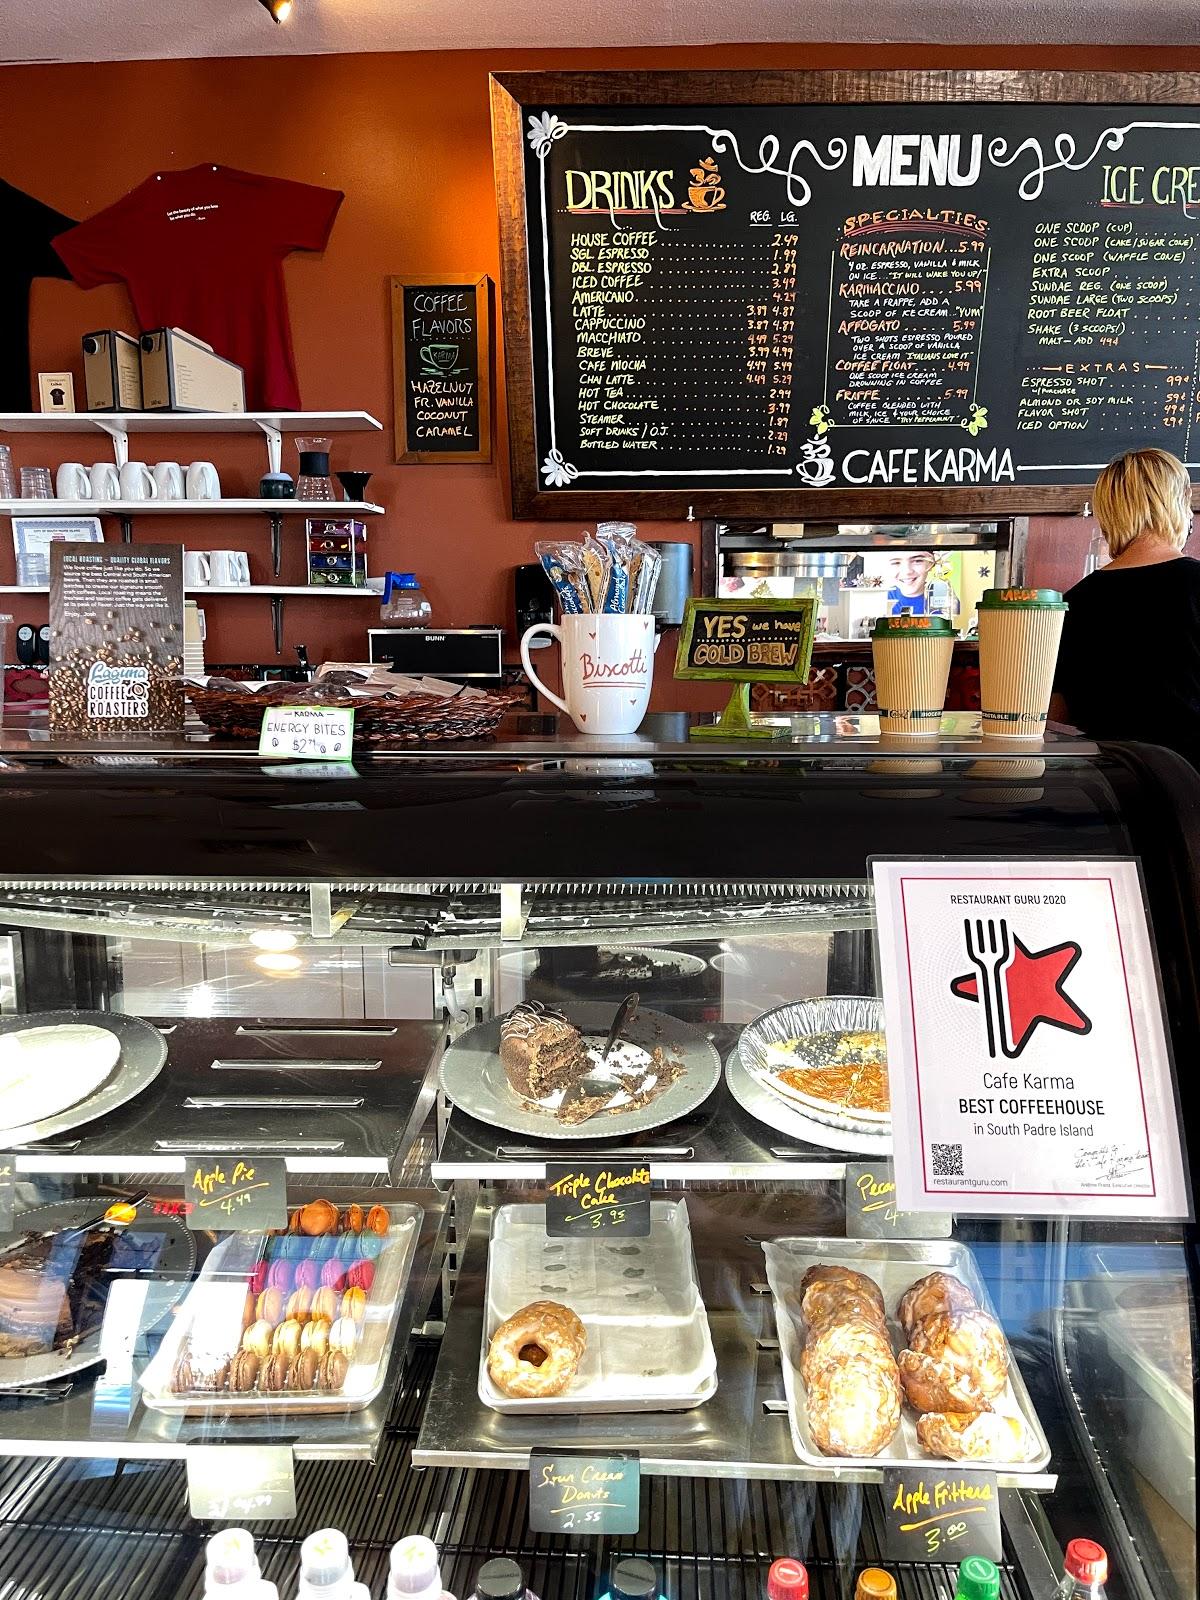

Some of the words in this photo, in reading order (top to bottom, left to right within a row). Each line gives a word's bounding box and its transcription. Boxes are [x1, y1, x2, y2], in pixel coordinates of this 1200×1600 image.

[853, 134, 982, 186] MENU
[1100, 166, 1144, 204] ICE
[564, 169, 675, 217] DRINKS
[750, 210, 771, 223] REG.
[781, 211, 798, 222] LG.
[1035, 224, 1061, 234] ONE
[1065, 222, 1100, 233] SCOOP
[1106, 222, 1132, 235] (CUP)
[571, 233, 609, 246] HOUSE
[613, 231, 657, 246] COFFEE
[771, 234, 798, 246] 2.49
[1034, 237, 1059, 247] ONE
[1063, 237, 1100, 247] SCOOP
[598, 248, 649, 260] ESPRESSO
[774, 250, 796, 262] 1.99
[1033, 253, 1060, 263] ONE
[1061, 253, 1094, 262] SCOOP
[1154, 252, 1185, 264] CONE)
[598, 262, 652, 274] ESPRESSO
[1032, 268, 1068, 278] EXTRA
[1075, 267, 1110, 277] SCOOP
[572, 276, 598, 289] ICED
[601, 275, 644, 288] COFFEE
[772, 278, 796, 290] 3.49
[955, 281, 982, 293] 5.99
[1030, 281, 1073, 292] SUNDAE
[1080, 282, 1103, 291] REG.
[1110, 280, 1131, 291] (ONE
[1136, 280, 1167, 292] SCOOP)
[414, 294, 467, 313] COFFEE
[572, 291, 634, 305] AMERICANO
[1029, 294, 1070, 305] SUNDAE
[1076, 294, 1108, 305] LARGE
[1112, 294, 1134, 304] (TWO
[1137, 293, 1178, 304] SCOOPS)
[573, 305, 605, 318] LATTE
[1028, 309, 1057, 319] ROOT
[1060, 309, 1089, 318] BEER
[1096, 308, 1130, 318] FLOAT
[412, 318, 472, 338] FLAVORS
[575, 318, 646, 330] CAPPUCCINO
[838, 320, 900, 335] AFFOGATO
[1028, 324, 1062, 334] SHAKE
[576, 332, 641, 345] MACCHIATO
[576, 346, 614, 358] BREVE
[579, 360, 606, 371] CAFE
[611, 360, 646, 371] MOCHA
[835, 360, 880, 372] COFFEE
[882, 362, 917, 372] FLOAT
[1066, 362, 1140, 374] EXTRAS
[580, 374, 602, 385] CHAI
[606, 374, 635, 385] LATTE
[1022, 377, 1072, 387] ESPRESSO
[1077, 377, 1107, 386] SHOT
[411, 380, 473, 394] HAZELNUT
[579, 388, 600, 398] HOT
[604, 387, 624, 398] TEA
[836, 389, 880, 401] FRAPPE
[1020, 398, 1062, 406] ALMOND
[1086, 397, 1104, 405] SOY
[1108, 396, 1134, 404] MILK
[414, 397, 433, 408] FR.
[436, 397, 473, 407] VANILLA
[578, 401, 600, 411] HOT
[604, 401, 659, 410] CHOCOLATE
[417, 411, 468, 421] COCONUT
[1018, 408, 1054, 417] FLAVOR
[1062, 408, 1089, 416] SHOT
[579, 414, 625, 425] STEAMER
[1017, 420, 1042, 430] ICED
[1048, 420, 1088, 430] OPTION
[416, 426, 472, 437] CARAMEL
[579, 427, 602, 436] SOFT
[606, 428, 639, 436] DRINKS
[650, 427, 668, 436] O.J.
[580, 439, 619, 449] BOTTLED
[622, 441, 658, 450] WATER
[842, 449, 918, 484] CAFE
[924, 447, 1015, 482] KARMA
[704, 616, 748, 638] YES
[775, 620, 801, 632] have
[694, 644, 744, 664] COLD
[747, 643, 798, 666] BREW
[580, 649, 648, 680] Biscotti
[91, 663, 146, 682] Laguna
[90, 686, 125, 699] COFFEE
[90, 702, 146, 716] ROASTERS
[267, 722, 309, 734] ENERGY
[315, 724, 346, 736] BITES
[950, 895, 1012, 905] RESTAURANT
[1014, 895, 1041, 905] GURU
[1043, 895, 1066, 905] 2020
[983, 1073, 1018, 1089] Cafe
[1023, 1073, 1075, 1090] Karma
[959, 1099, 994, 1114] BEST
[999, 1100, 1105, 1115] COFFEEHOUSE
[974, 1123, 984, 1135] in
[987, 1123, 1020, 1136] South
[1024, 1124, 1056, 1136] Padre
[1060, 1124, 1094, 1137] Island
[192, 1165, 226, 1194] Apple
[232, 1162, 254, 1185] Pie
[550, 1172, 590, 1198] Triple
[595, 1168, 650, 1194] Chocolate
[934, 1178, 1008, 1188] restaurantguru.com
[221, 1194, 251, 1215] 4.49
[581, 1190, 619, 1209] Cake
[590, 1210, 625, 1228] 3.95
[538, 1464, 574, 1487] Sour
[582, 1466, 624, 1483] Cream
[562, 1485, 610, 1503] Donuts
[893, 1482, 930, 1514] Apple
[935, 1480, 994, 1509] Fritters
[563, 1511, 601, 1528] 2.55
[925, 1522, 968, 1552] 3.00
